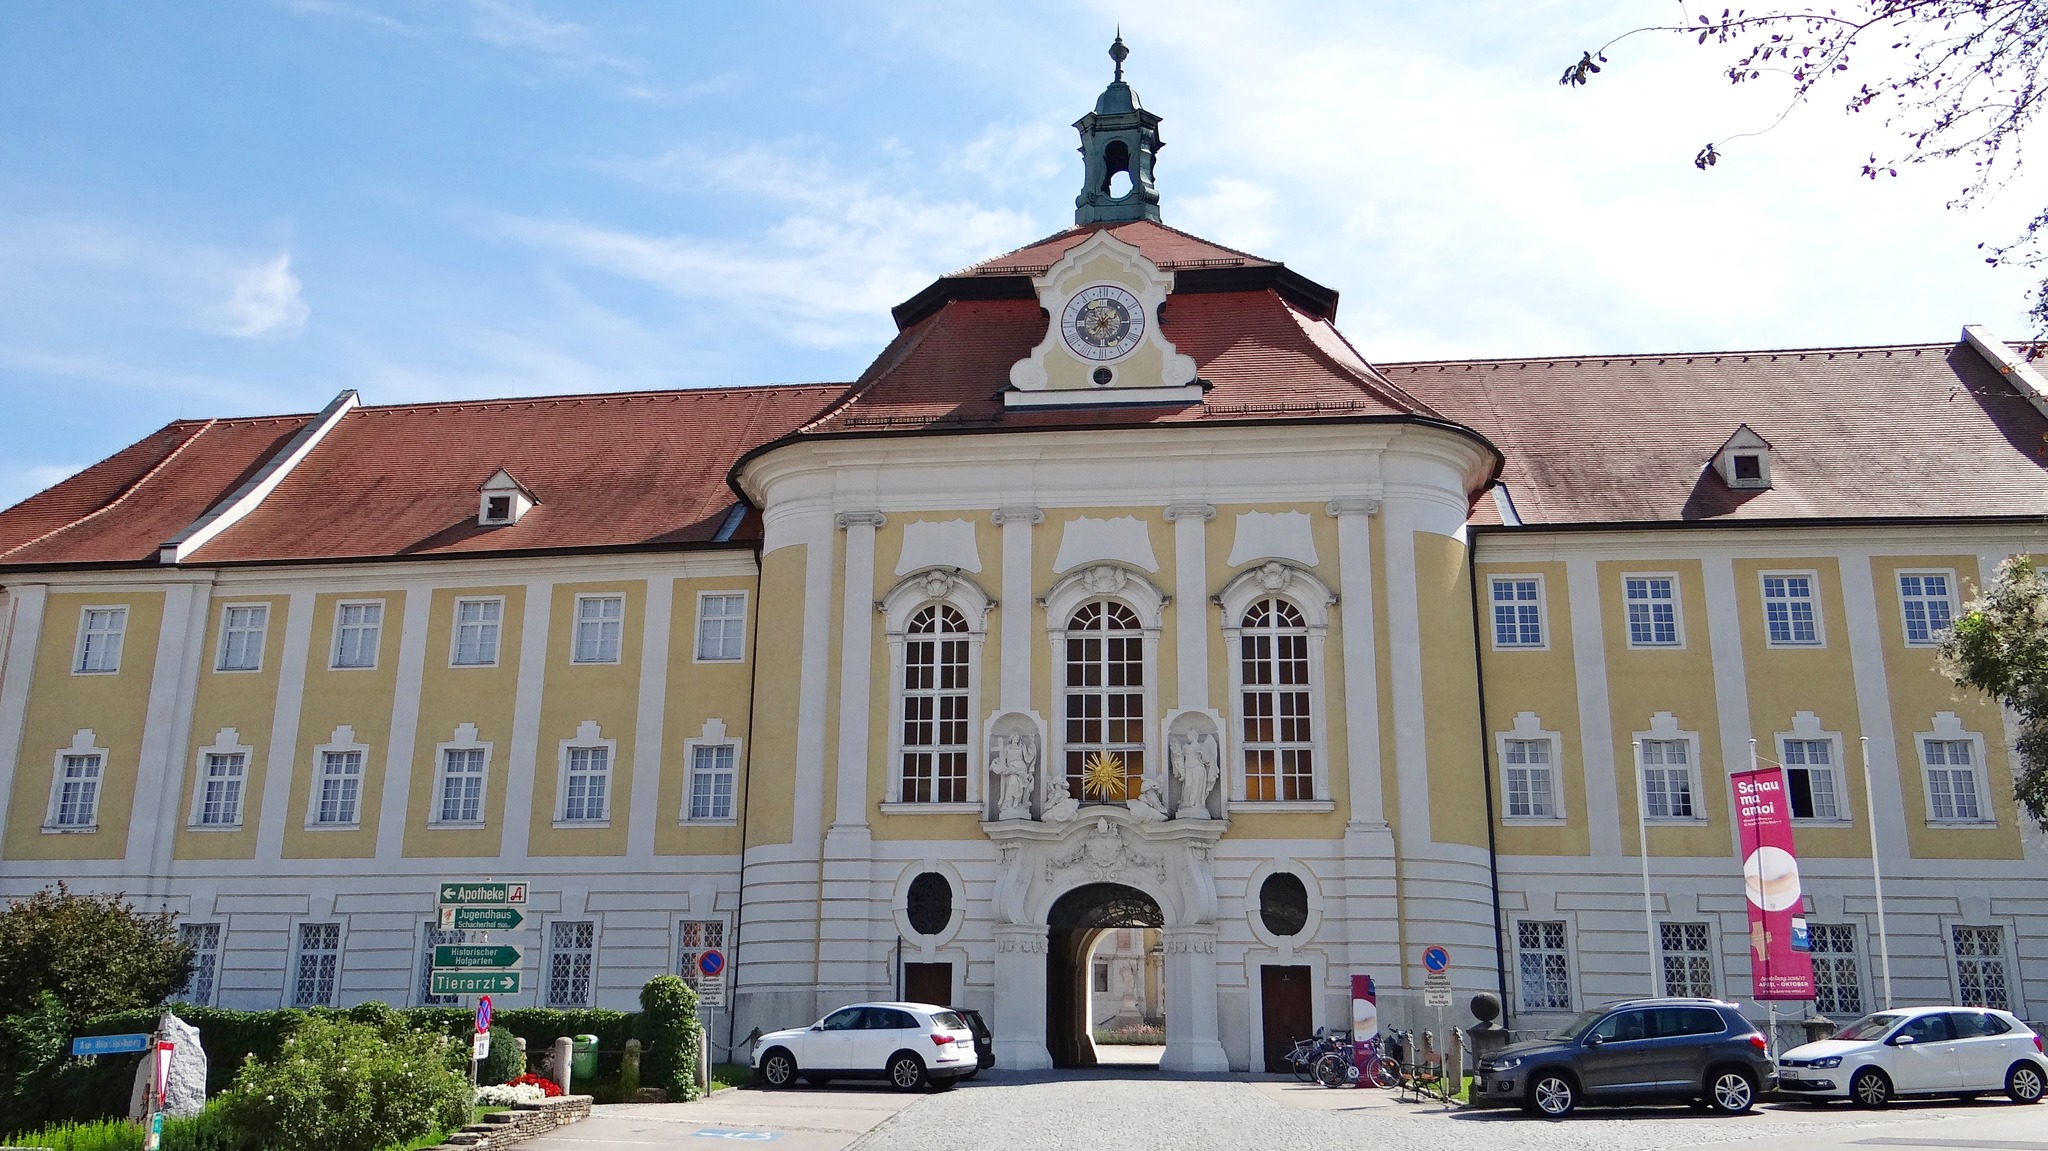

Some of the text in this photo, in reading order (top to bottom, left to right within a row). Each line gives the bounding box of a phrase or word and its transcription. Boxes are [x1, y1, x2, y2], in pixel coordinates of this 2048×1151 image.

[1737, 780, 1780, 794] Schau
[1740, 794, 1761, 805] ma
[1741, 801, 1775, 816] amoi
[457, 886, 504, 903] Apotheke
[458, 909, 512, 921] Jugendhaus
[457, 920, 497, 928] Schacherhof
[451, 947, 499, 956] Historischer
[455, 957, 493, 966] Hofgarten
[437, 976, 496, 990] Tierarzt
